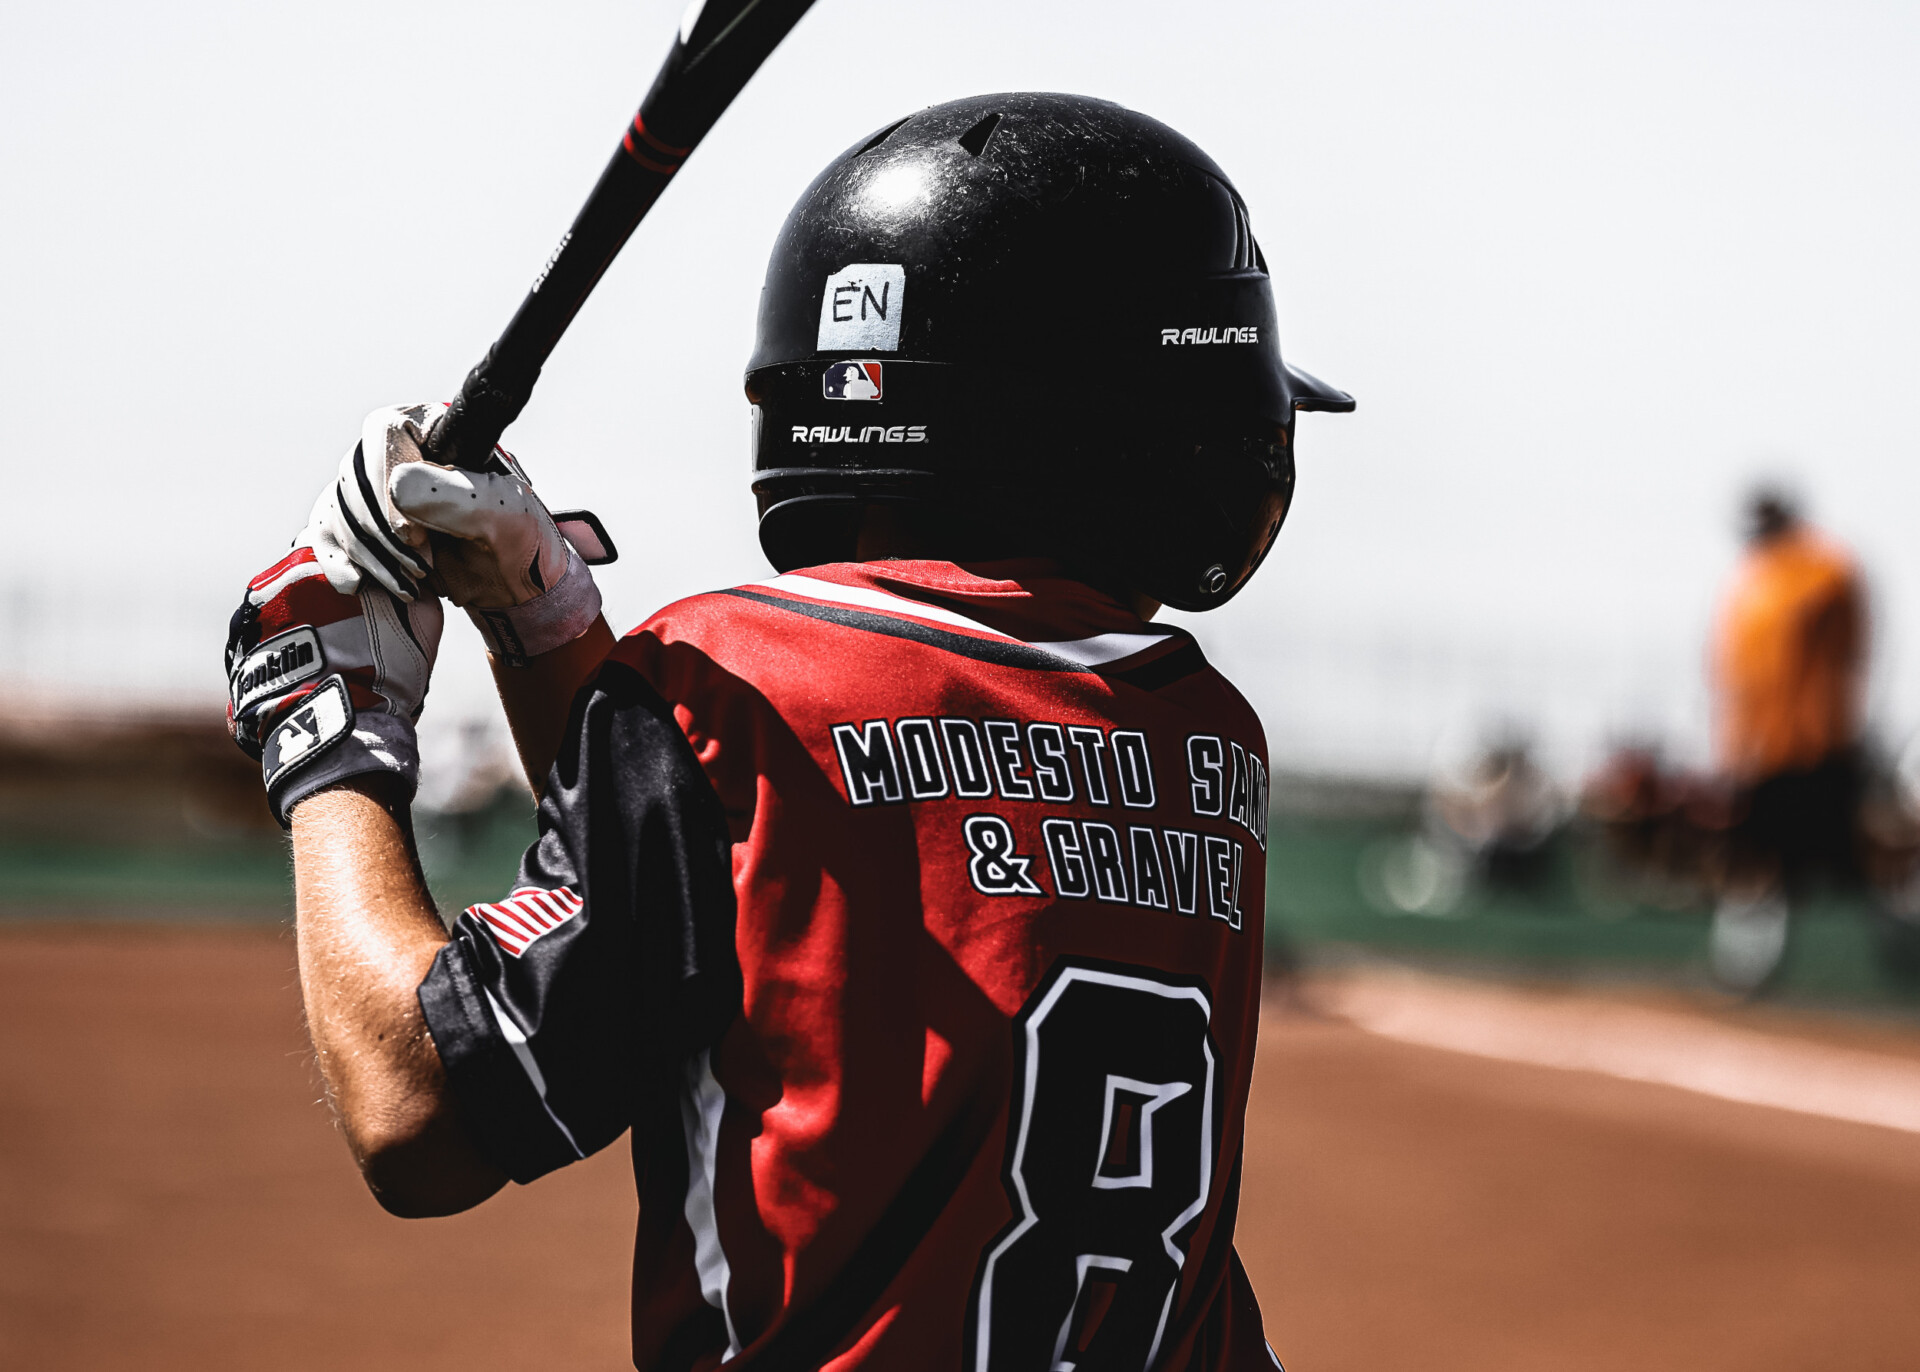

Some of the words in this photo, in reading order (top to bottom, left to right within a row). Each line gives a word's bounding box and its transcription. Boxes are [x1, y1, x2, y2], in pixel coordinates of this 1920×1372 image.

[832, 280, 890, 323] EN
[1160, 326, 1259, 346] RAWLINGS
[791, 425, 928, 444] RAWLINGS
[832, 717, 1157, 808] MODESTO
[964, 815, 1044, 895] &
[1041, 818, 1243, 930] GRAVEL
[968, 961, 1220, 1372] 8
